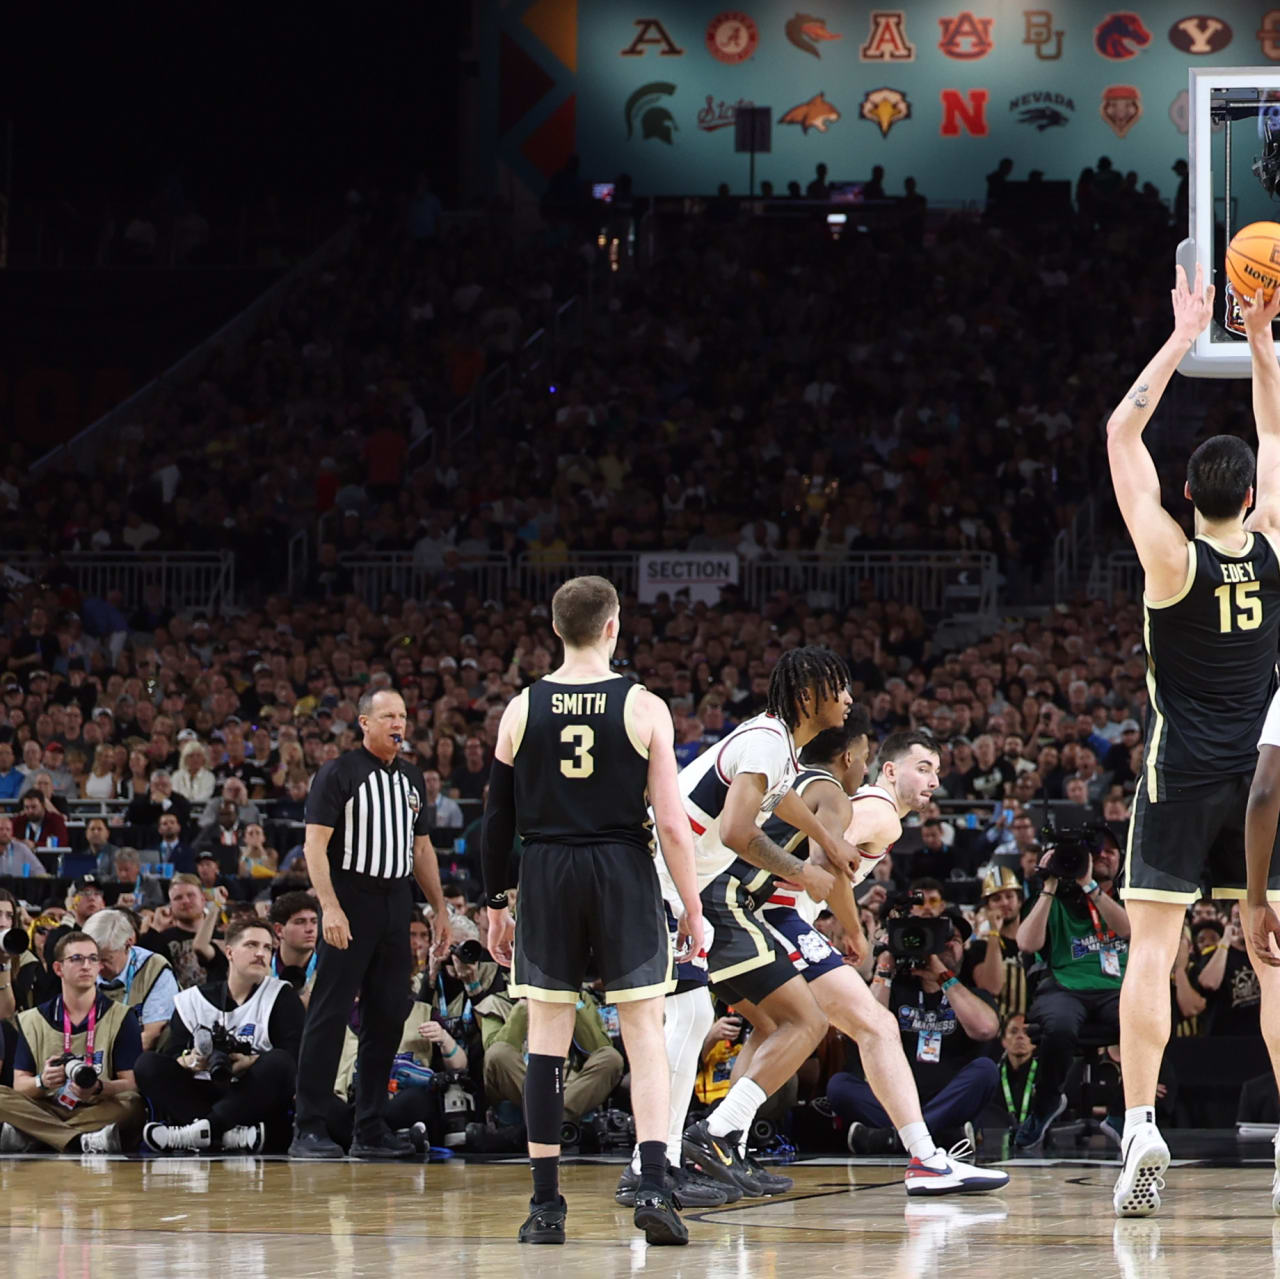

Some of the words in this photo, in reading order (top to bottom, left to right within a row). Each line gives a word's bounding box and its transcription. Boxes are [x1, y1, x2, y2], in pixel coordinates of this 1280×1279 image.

[940, 88, 989, 138] N
[1008, 90, 1077, 113] NEVADA
[648, 560, 730, 578] SECTION
[1219, 561, 1256, 583] EDEY
[1214, 581, 1263, 633] 15
[551, 693, 607, 715] SMITH
[559, 724, 595, 778] 3
